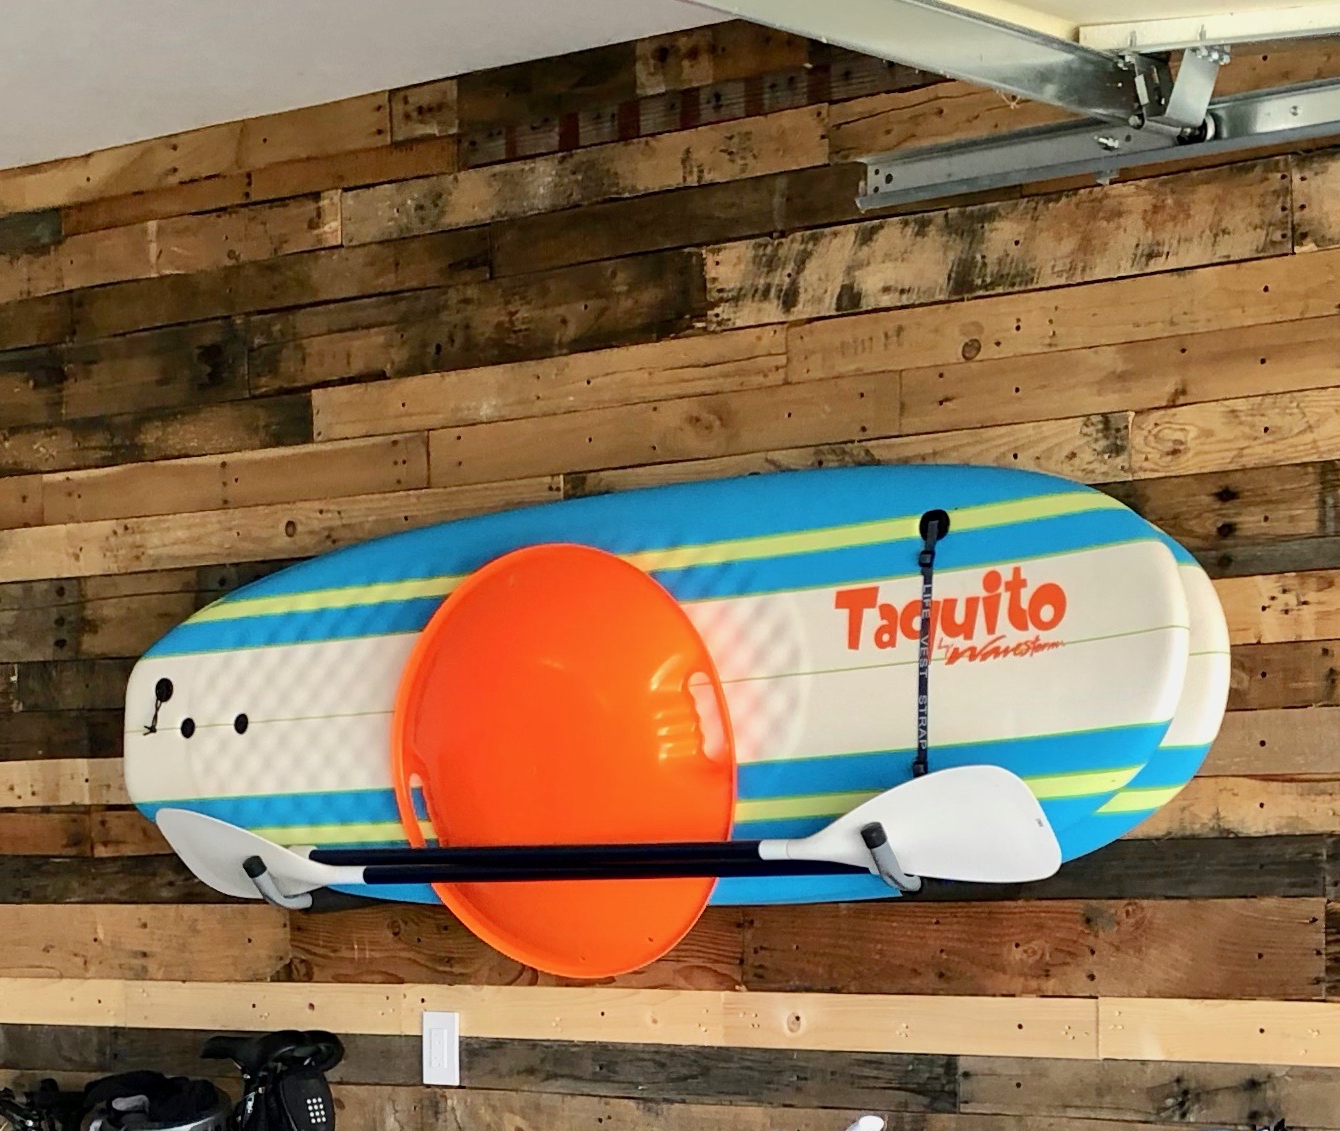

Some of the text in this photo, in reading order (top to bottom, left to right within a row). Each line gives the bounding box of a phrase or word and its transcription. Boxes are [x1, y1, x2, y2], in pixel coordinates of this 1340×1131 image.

[834, 566, 1067, 665] Taquito
[918, 584, 932, 750] LIFE VEST STRAP
